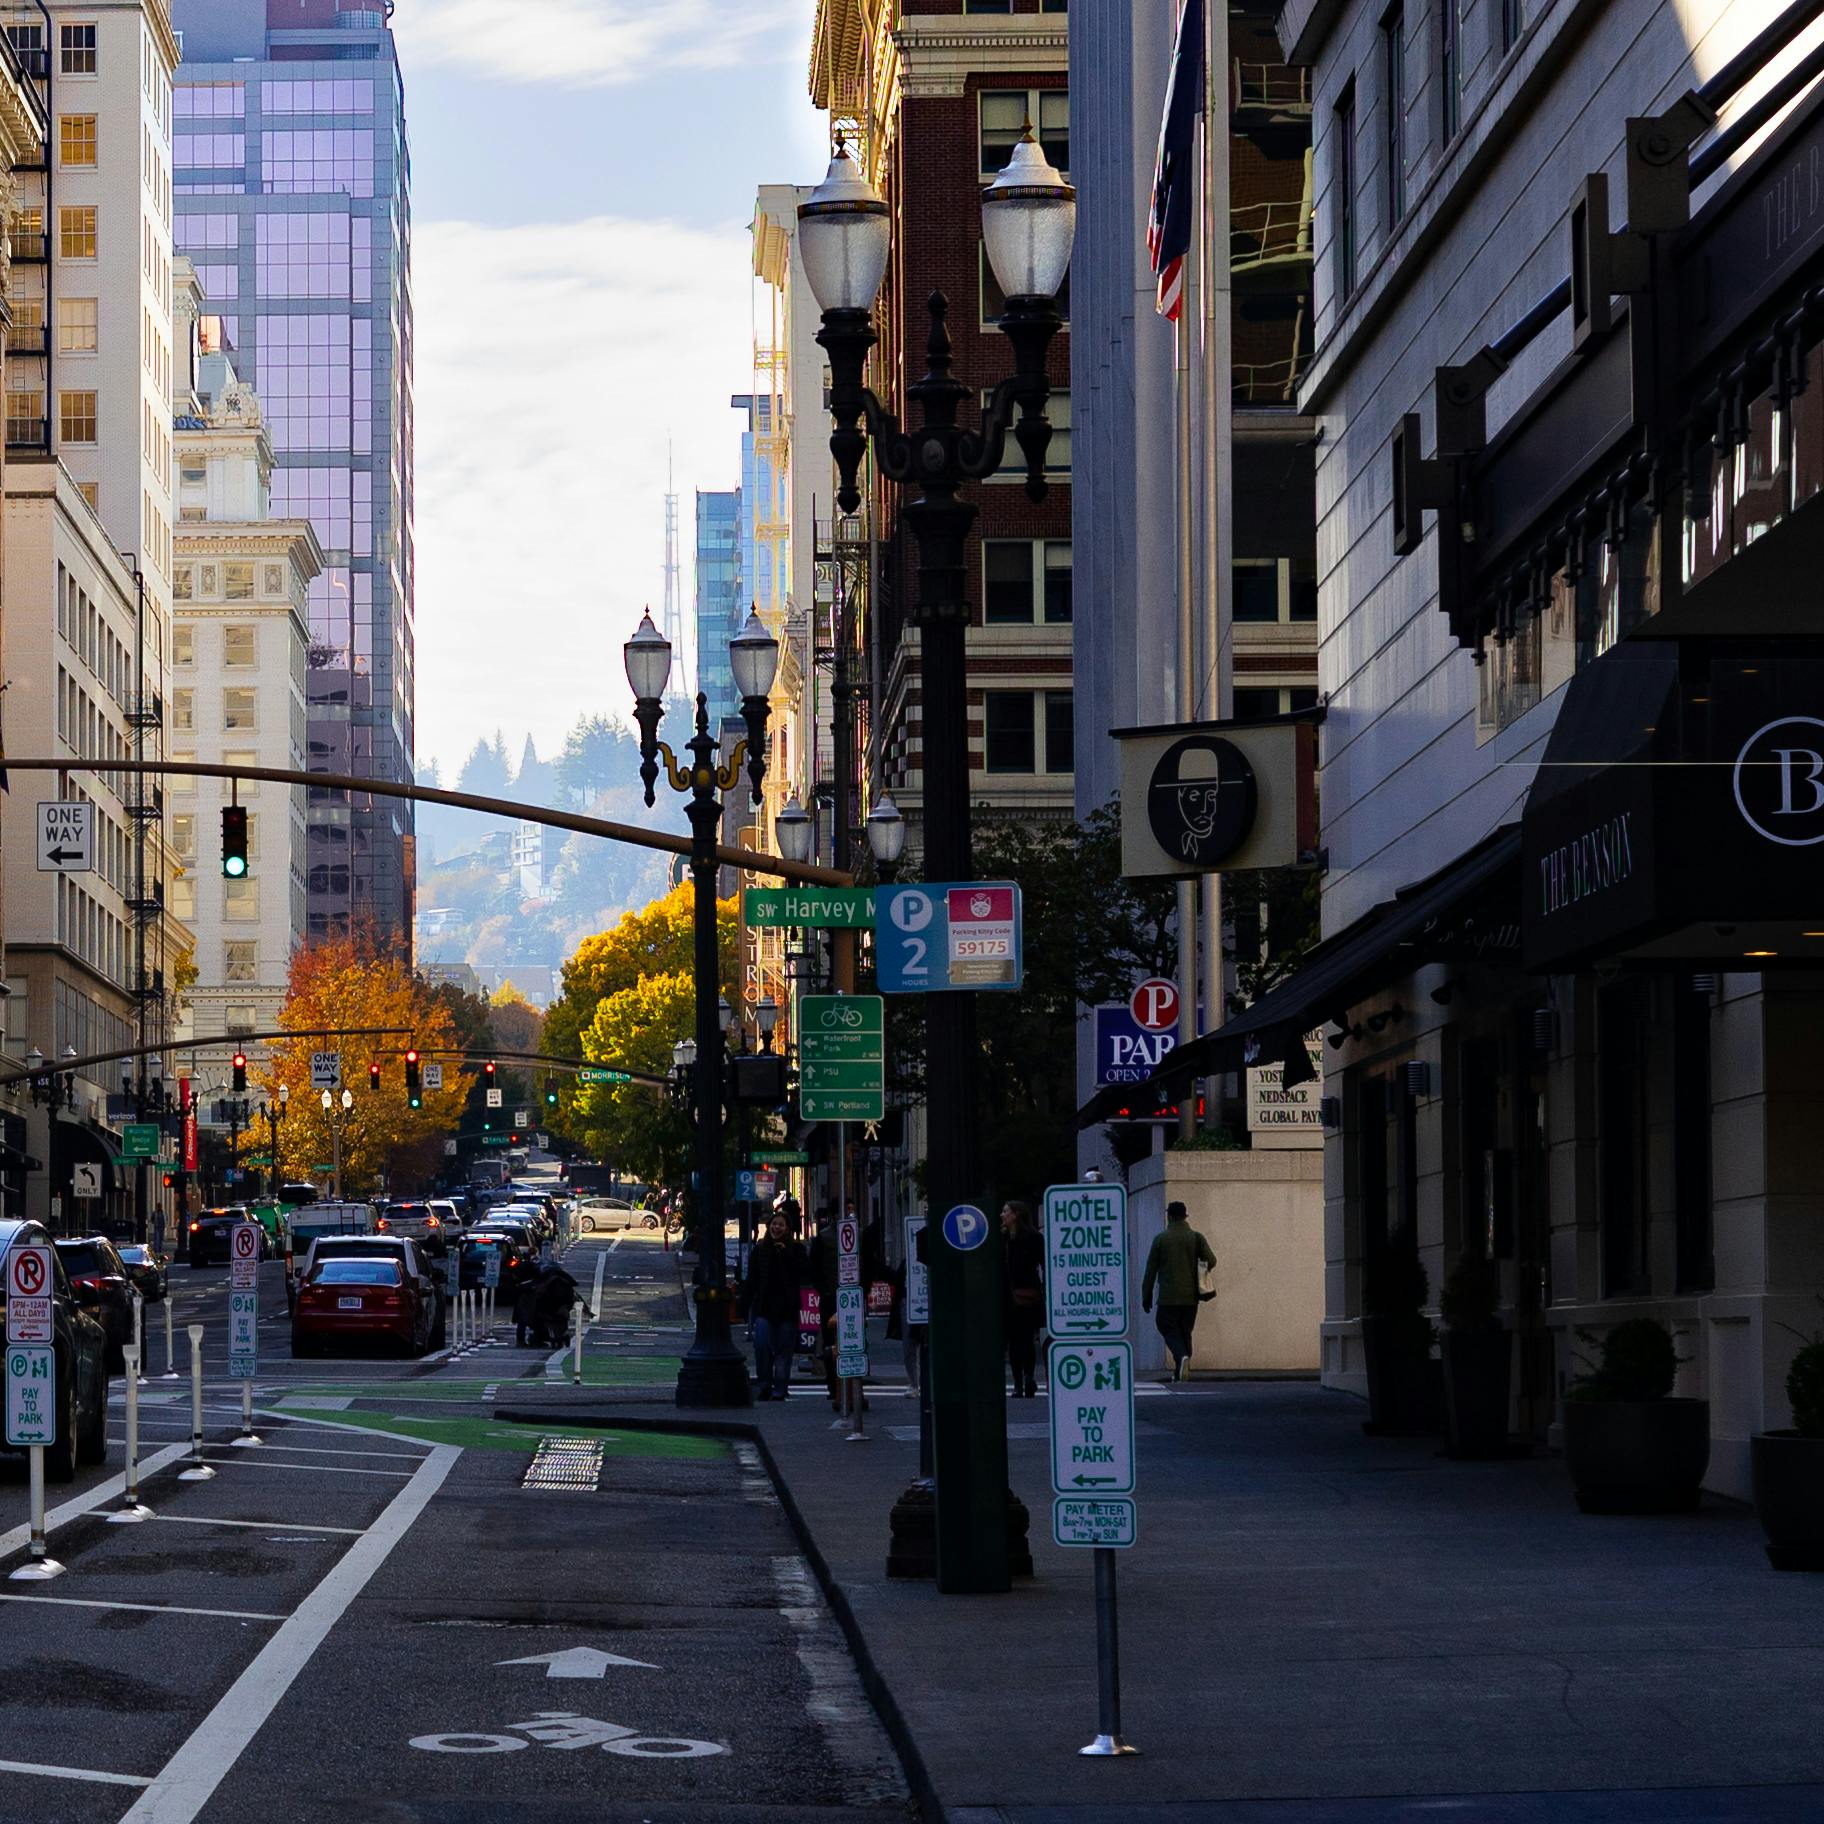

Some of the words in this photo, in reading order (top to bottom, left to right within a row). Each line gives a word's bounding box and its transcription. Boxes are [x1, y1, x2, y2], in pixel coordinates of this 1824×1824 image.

[1770, 748, 1824, 815] B
[46, 808, 83, 824] ONE
[45, 826, 84, 842] WAY
[1540, 847, 1569, 917] THE
[1572, 812, 1633, 902] BENSON
[757, 903, 776, 918] SW
[785, 897, 855, 923] Harvey
[902, 896, 924, 926] P
[957, 940, 1007, 955] 59175
[901, 937, 929, 975] 2
[1143, 985, 1175, 1026] P
[823, 1035, 862, 1043] Waterfront
[823, 1045, 841, 1053] Park
[1109, 1034, 1175, 1066] PAR
[314, 1054, 337, 1063] ONE
[314, 1064, 338, 1072] WAY
[823, 1067, 839, 1077] PSU
[1106, 1068, 1140, 1082] OPEN
[1259, 1090, 1308, 1104] NEDSPACE
[823, 1101, 834, 1110] SW
[838, 1101, 871, 1111] Portland
[108, 1112, 137, 1121] verizon
[1260, 1110, 1299, 1124] GLOBAL
[77, 1187, 97, 1195] ONLY
[741, 1184, 751, 1196] 2
[1054, 1199, 1118, 1222] HOTEL
[955, 1213, 976, 1244] P
[1060, 1226, 1113, 1249] ZONE
[1053, 1254, 1066, 1268] 15
[1069, 1252, 1122, 1268] MINUTES
[1067, 1272, 1108, 1287] GUEST
[12, 1300, 48, 1309] 5PM-12AM
[808, 1293, 821, 1307] Ev
[1061, 1291, 1114, 1306] LOADING
[29, 1310, 46, 1318] DAYS
[800, 1310, 821, 1324] Wee
[1054, 1308, 1066, 1317] ALL
[1106, 1306, 1123, 1316] DAYS
[238, 1318, 248, 1326] PAY
[236, 1335, 251, 1343] PARK
[800, 1332, 815, 1347] Sp
[21, 1387, 39, 1399] PAY
[24, 1400, 37, 1412] TO
[18, 1412, 43, 1425] PARK
[1077, 1407, 1107, 1423] PAY
[1082, 1427, 1103, 1442] TO
[1072, 1446, 1114, 1462] PARK
[1065, 1504, 1084, 1514] PAY
[1087, 1504, 1124, 1515] METER
[1094, 1516, 1127, 1527] MON-SAT
[1103, 1528, 1119, 1539] SUN
